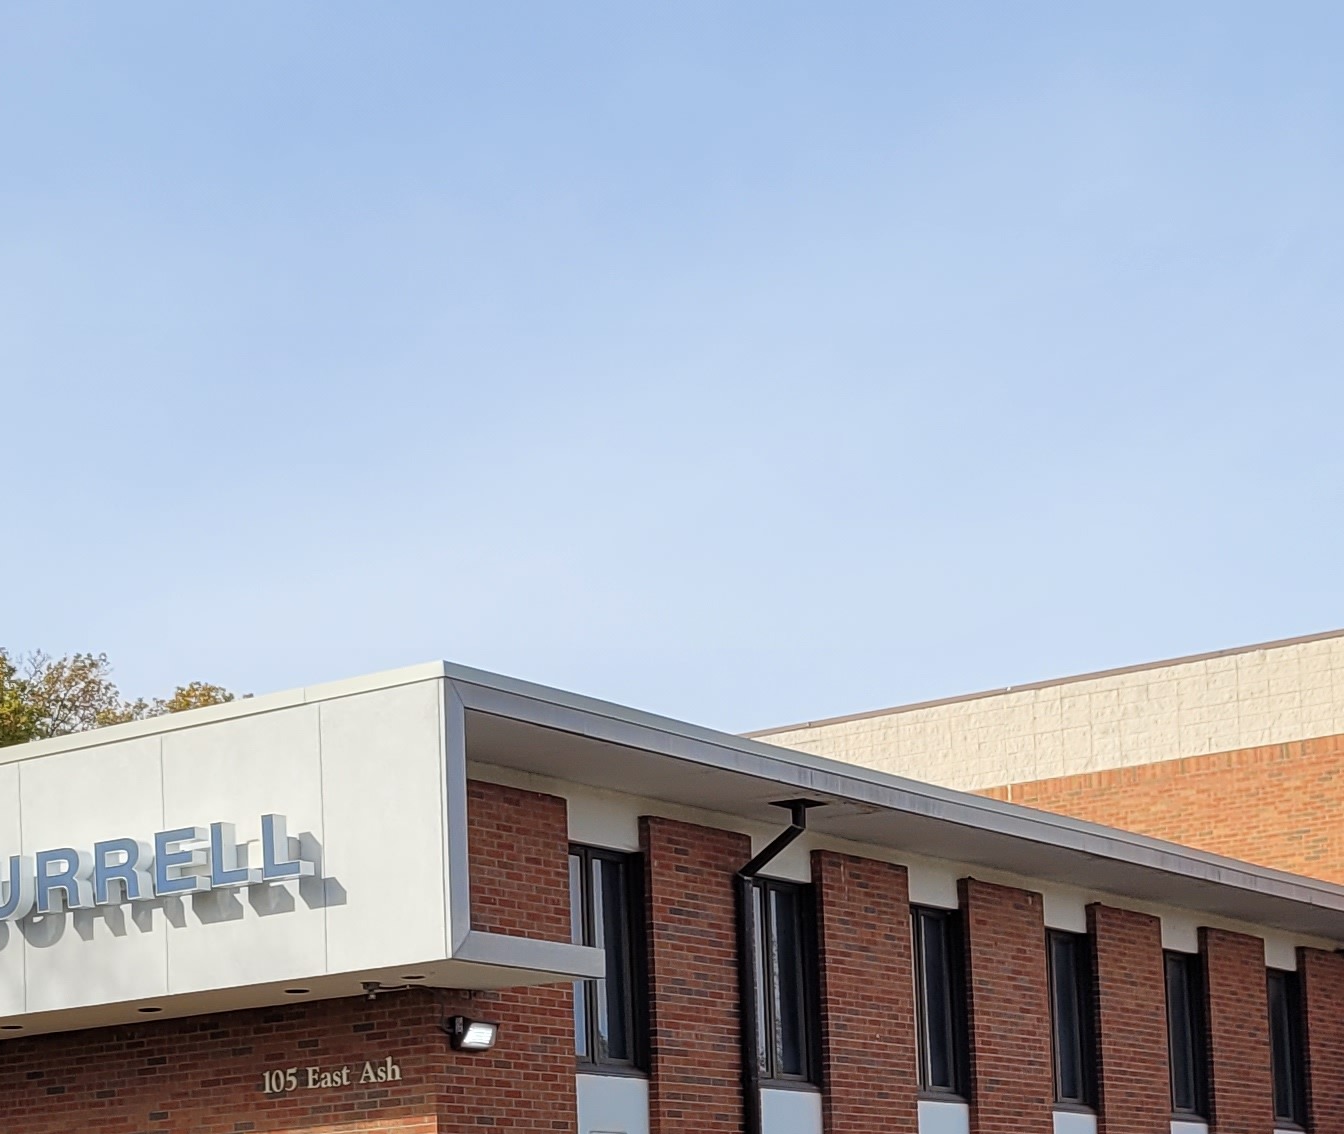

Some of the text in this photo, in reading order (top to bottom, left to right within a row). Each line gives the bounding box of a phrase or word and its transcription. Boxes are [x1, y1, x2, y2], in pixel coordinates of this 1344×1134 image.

[262, 1056, 402, 1093] 105 East Ash
